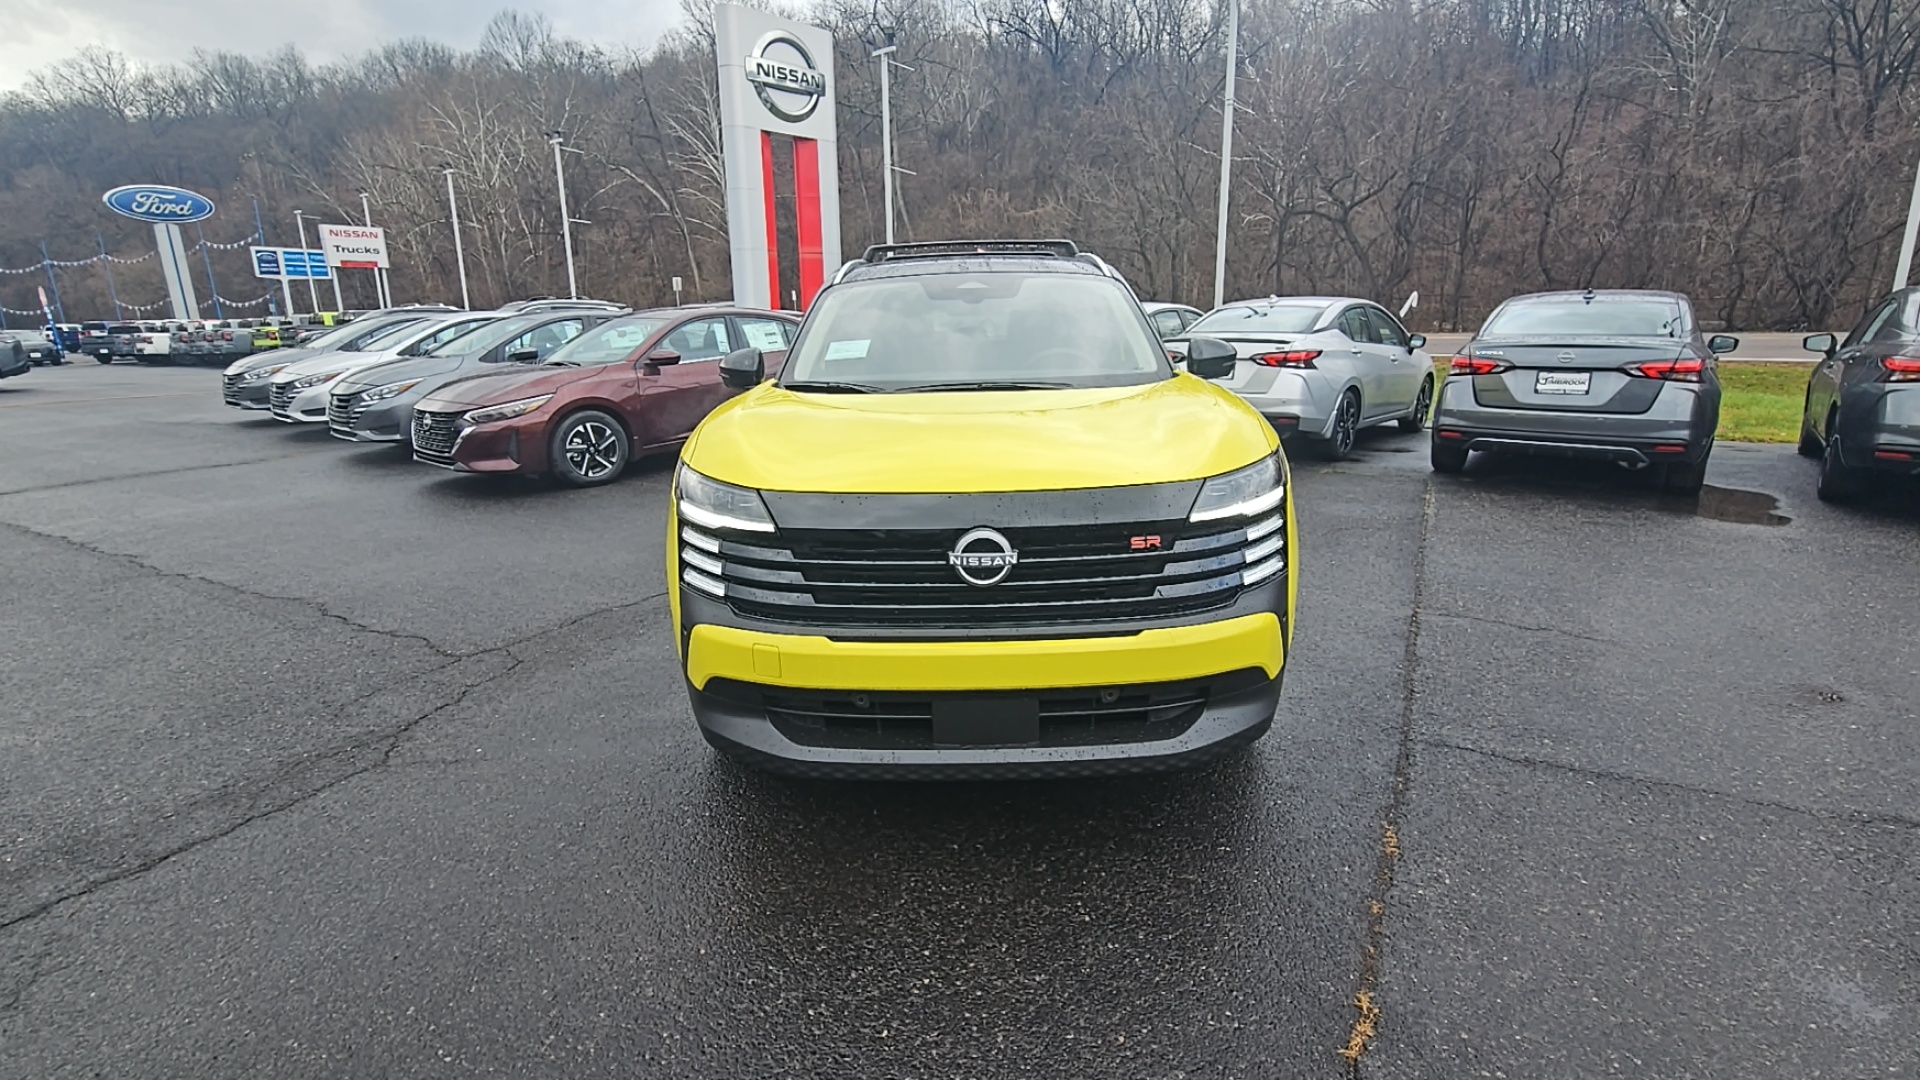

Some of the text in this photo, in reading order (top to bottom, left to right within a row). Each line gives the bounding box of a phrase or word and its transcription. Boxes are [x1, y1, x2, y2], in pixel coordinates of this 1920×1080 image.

[756, 62, 820, 89] NISSAN
[131, 191, 194, 215] Ford
[329, 229, 379, 239] NISSAN
[333, 244, 380, 254] Trucks
[1130, 535, 1161, 549] SR
[949, 555, 1017, 566] NISSAN
